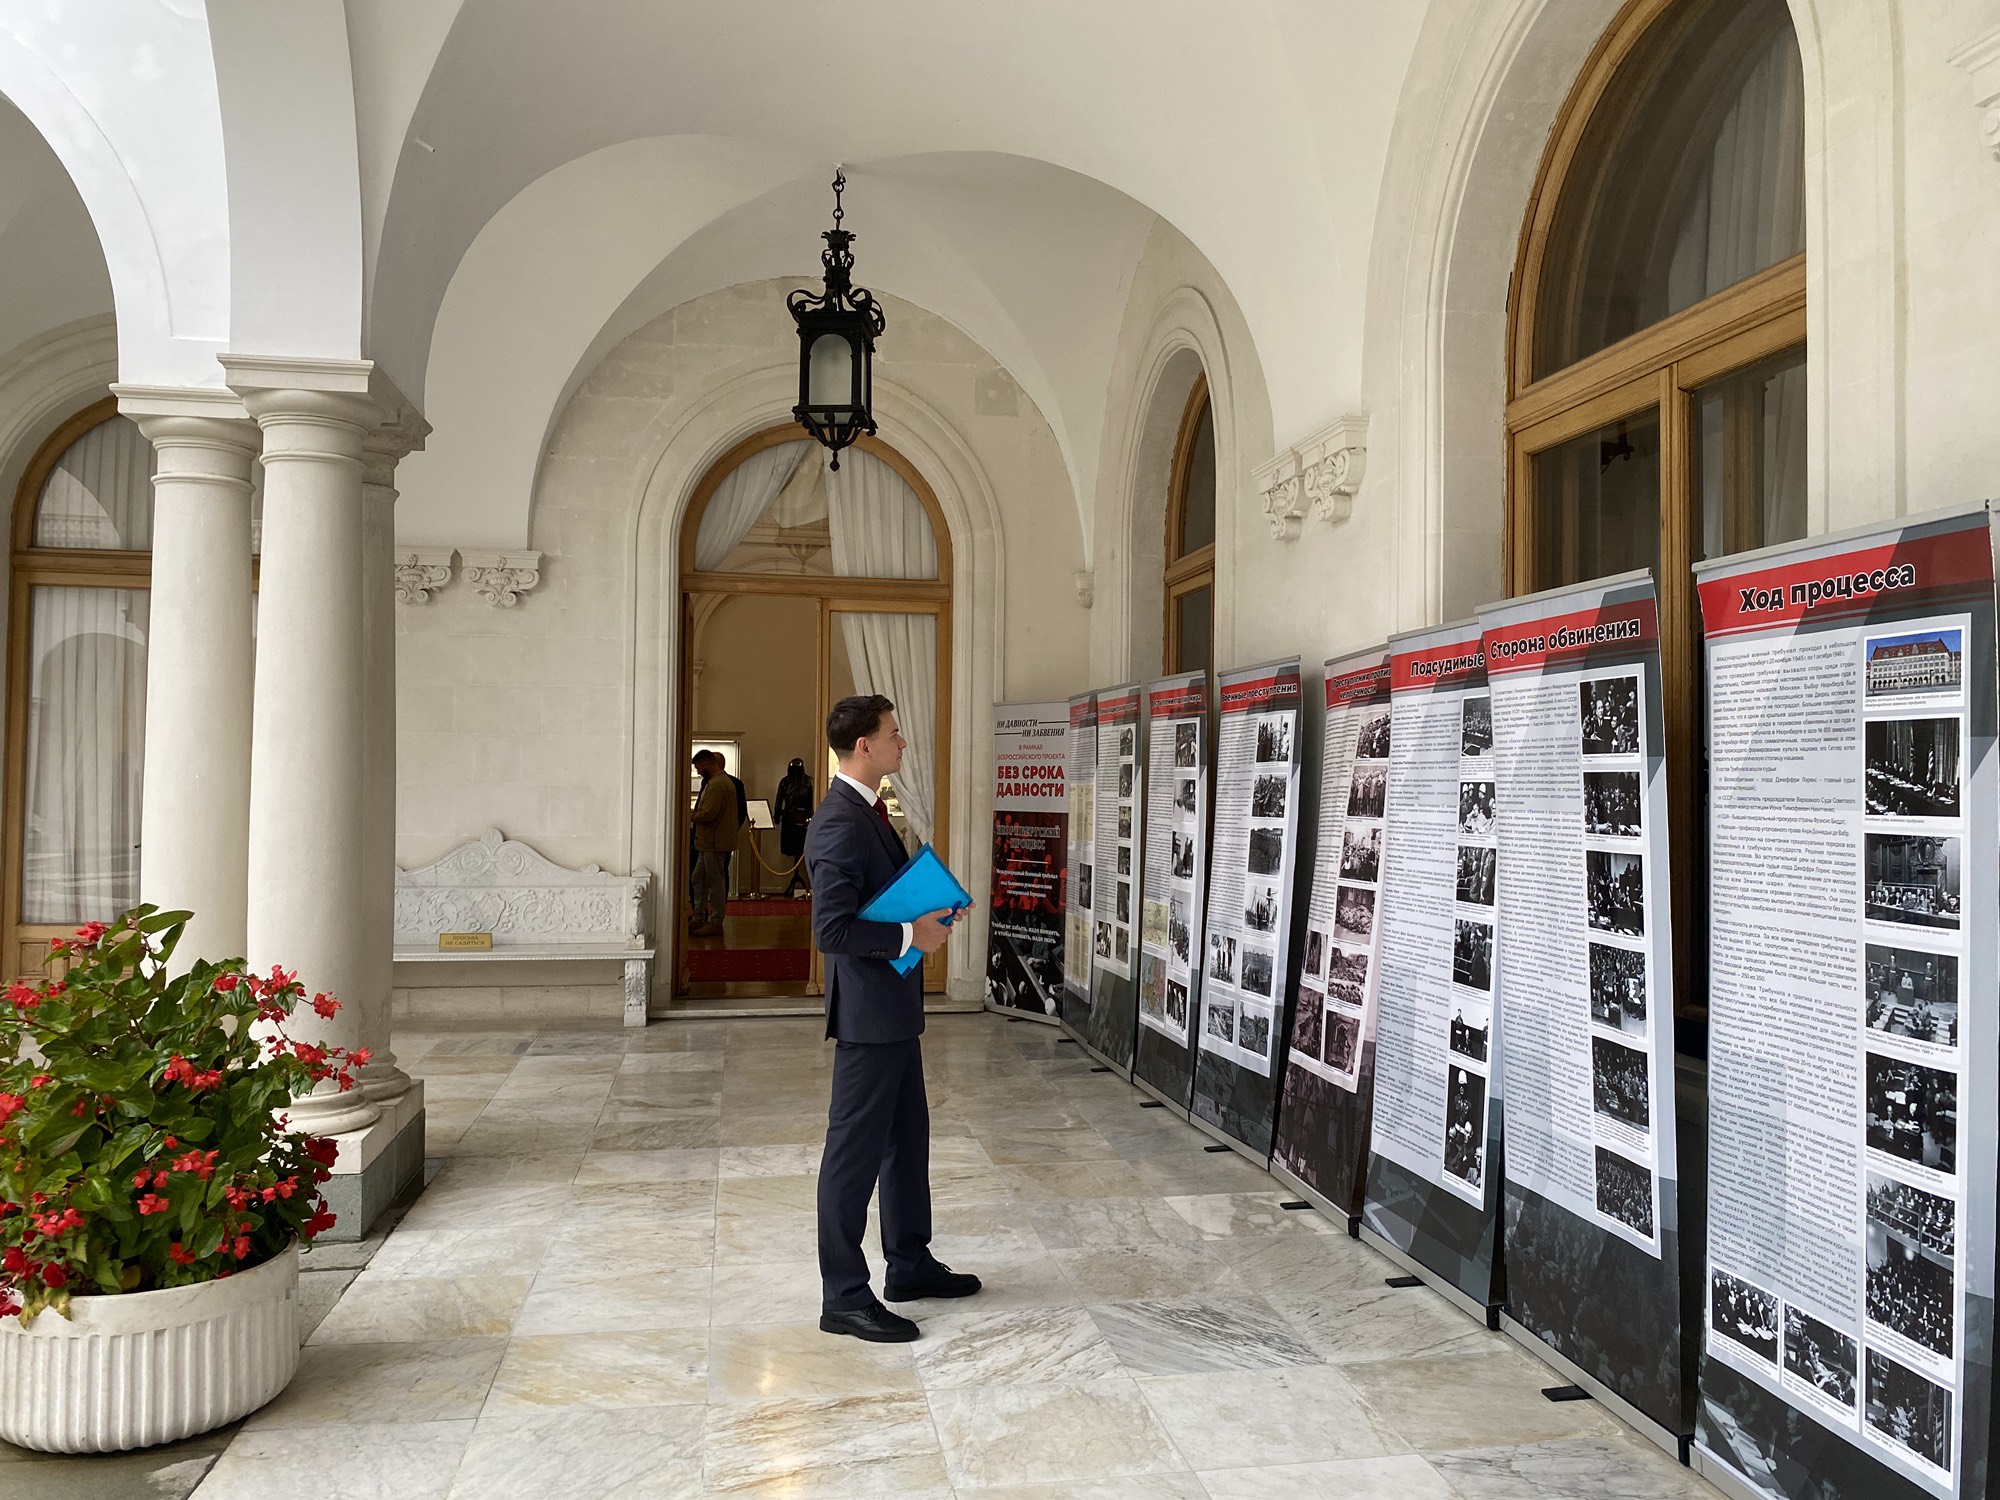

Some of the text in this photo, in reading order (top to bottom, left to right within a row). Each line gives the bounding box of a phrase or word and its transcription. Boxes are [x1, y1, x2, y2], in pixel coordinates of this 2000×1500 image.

[1739, 564, 1915, 613] Ход процесса
[1490, 619, 1641, 660] Сторона обвинения
[1411, 652, 1485, 677] Подсудимые
[1248, 683, 1297, 699] преступления
[1006, 719, 1037, 728] ДАВНОСТИ
[1032, 728, 1065, 737] ЗАБВЕНИЯ
[998, 766, 1065, 779] БЕЗ СРОКА
[996, 782, 1064, 798] ДАВНОСТИ
